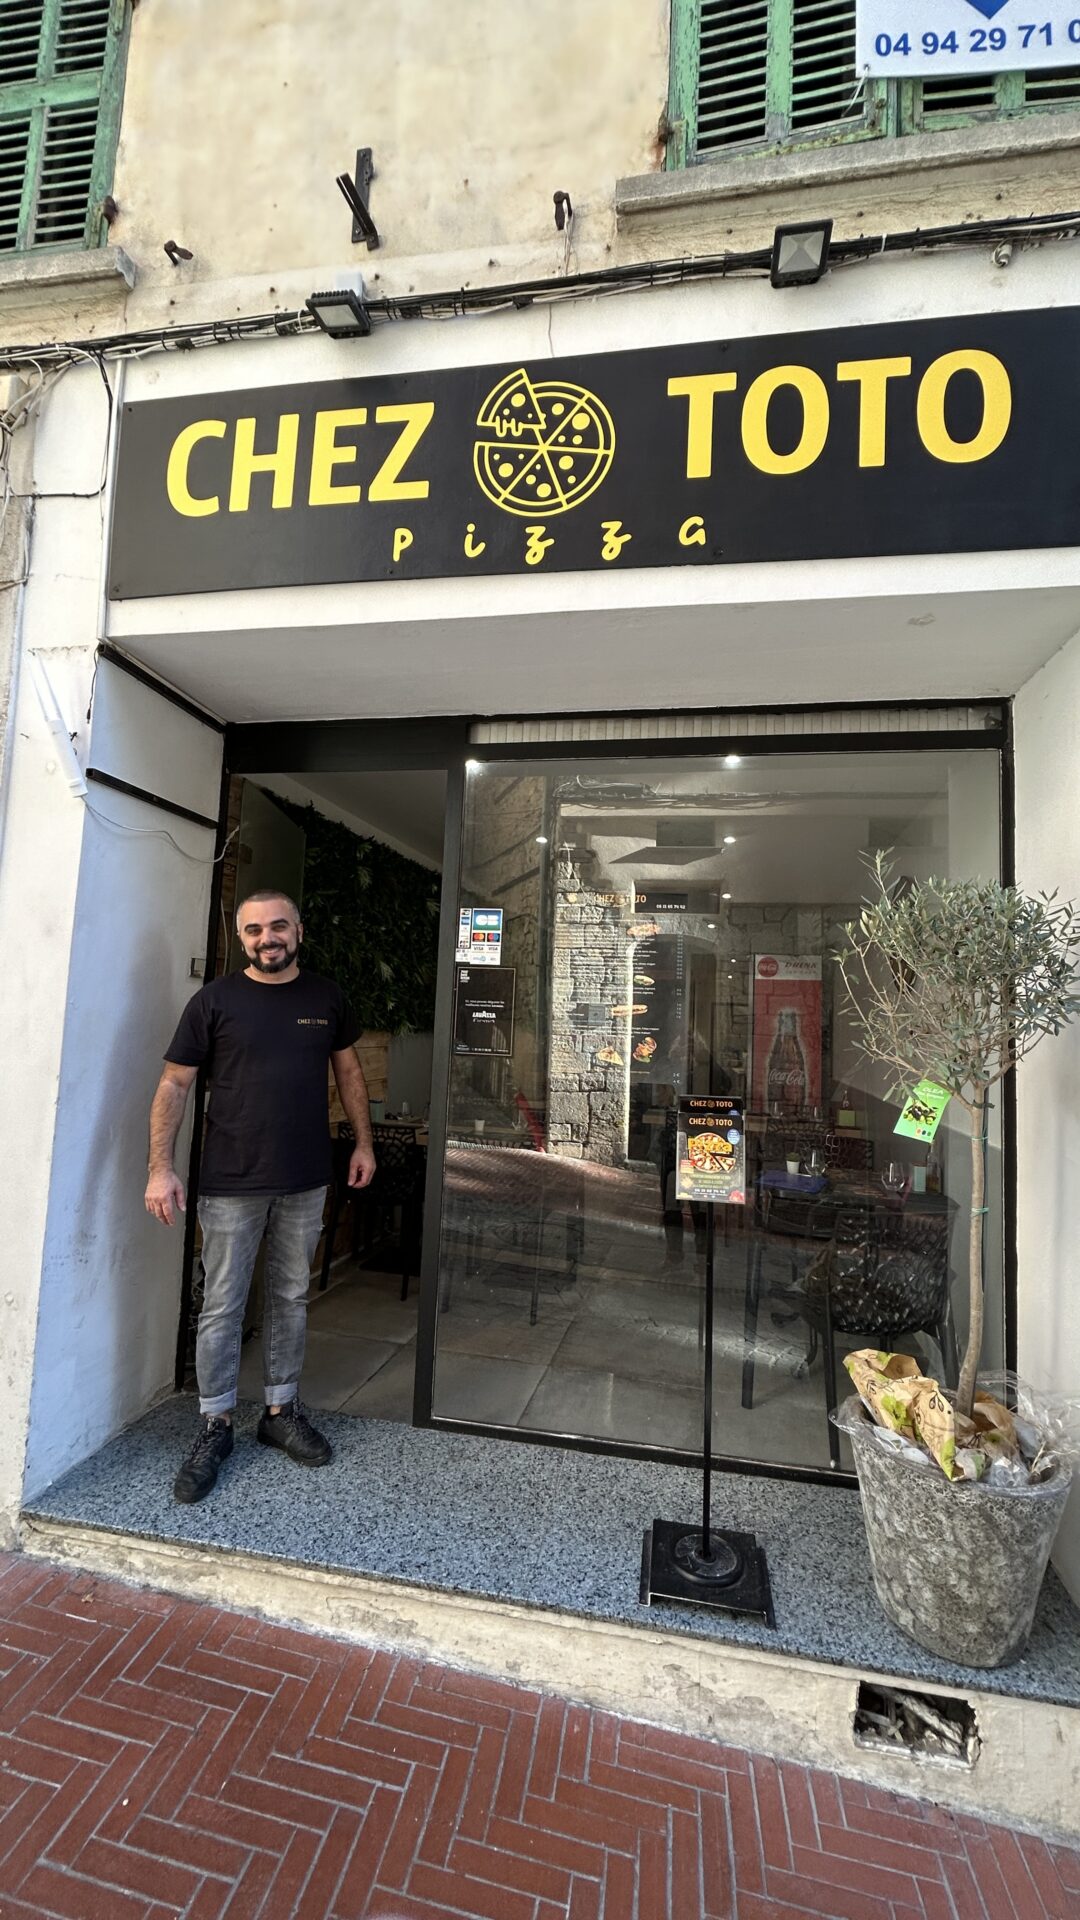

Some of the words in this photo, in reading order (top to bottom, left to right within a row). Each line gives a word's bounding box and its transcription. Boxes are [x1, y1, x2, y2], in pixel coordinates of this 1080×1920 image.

[875, 33, 911, 57] 04
[922, 31, 959, 55] 94
[969, 27, 1007, 53] 29
[1018, 22, 1053, 48] 71
[167, 402, 434, 518] CHEZ
[668, 350, 1011, 478] TOTO
[688, 1118, 706, 1126] CHEZ
[715, 1119, 733, 1127] TOTO
